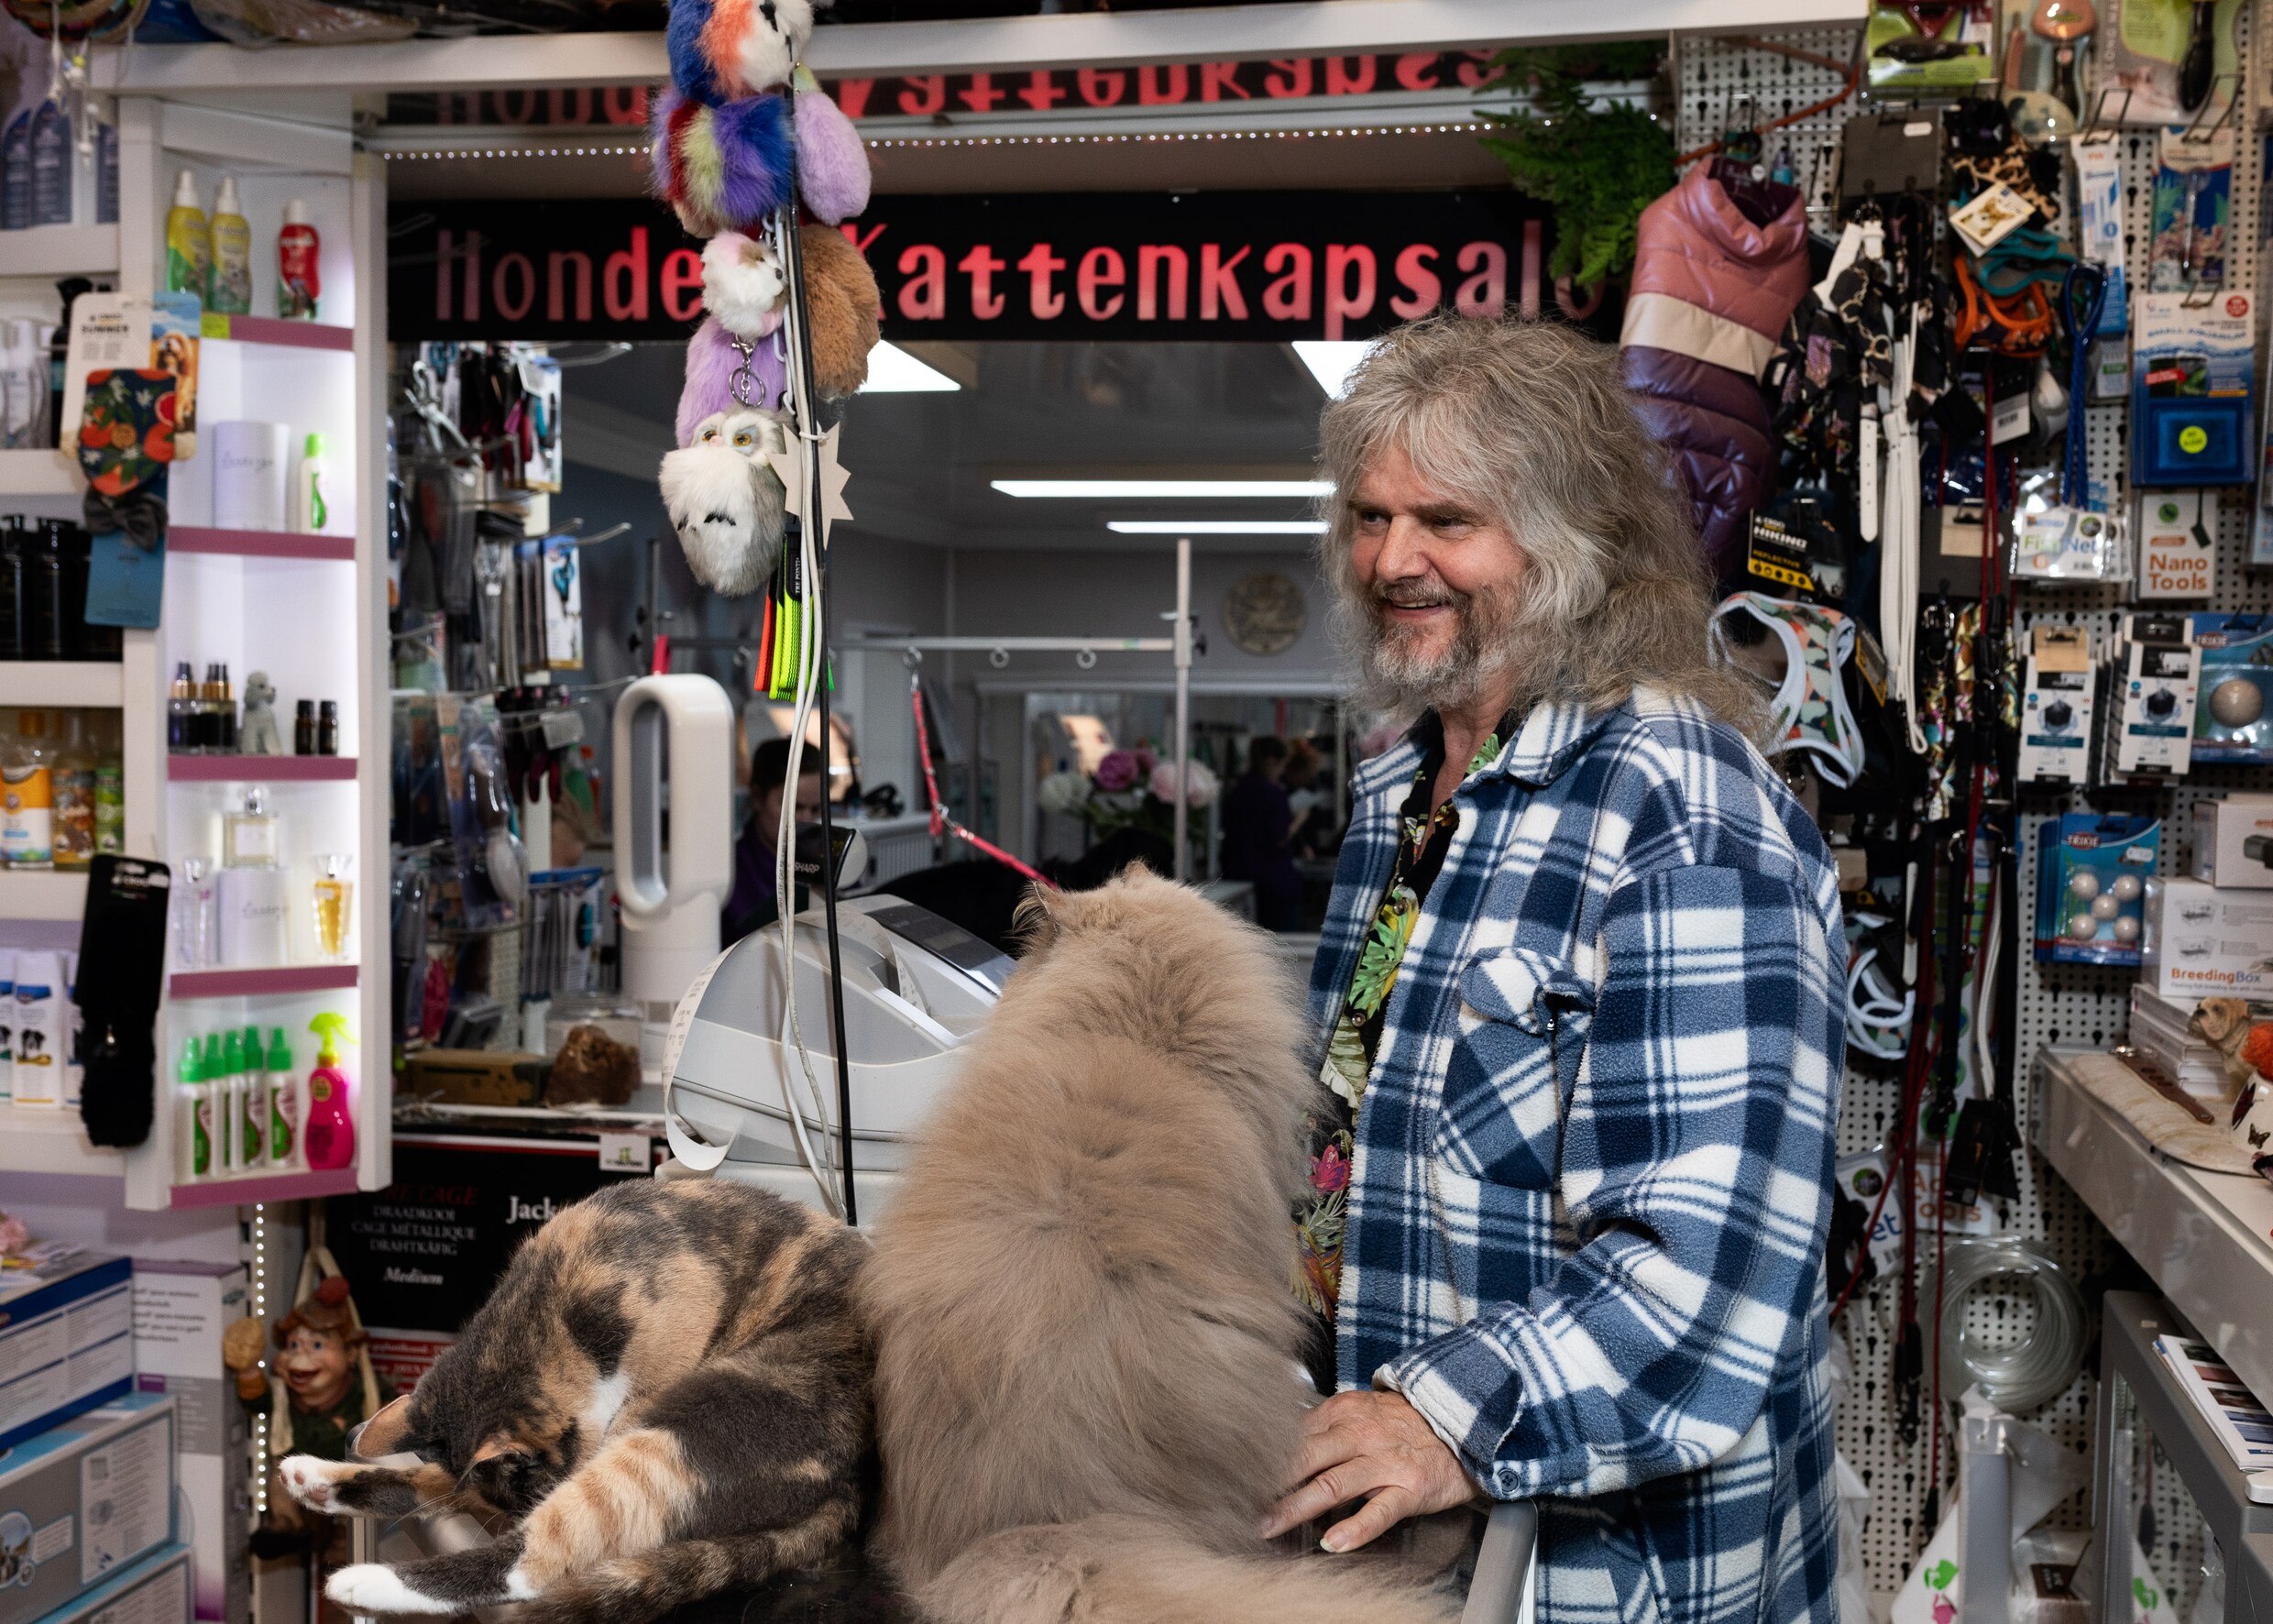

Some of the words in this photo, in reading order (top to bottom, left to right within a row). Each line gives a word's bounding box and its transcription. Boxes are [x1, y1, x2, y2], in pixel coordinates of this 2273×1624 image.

[1753, 525, 1808, 548] HIKING
[2148, 554, 2209, 572] Nano
[2148, 573, 2208, 591] Tools
[2067, 834, 2101, 848] TRIXIE
[794, 861, 820, 873] SHARP
[2171, 968, 2261, 984] BreedingBox
[417, 1183, 479, 1206] CAGE
[372, 1203, 456, 1222] DRAADKOOI
[1915, 1195, 1982, 1223] ools
[351, 1219, 388, 1234] CAGE
[381, 1265, 445, 1287] Medium
